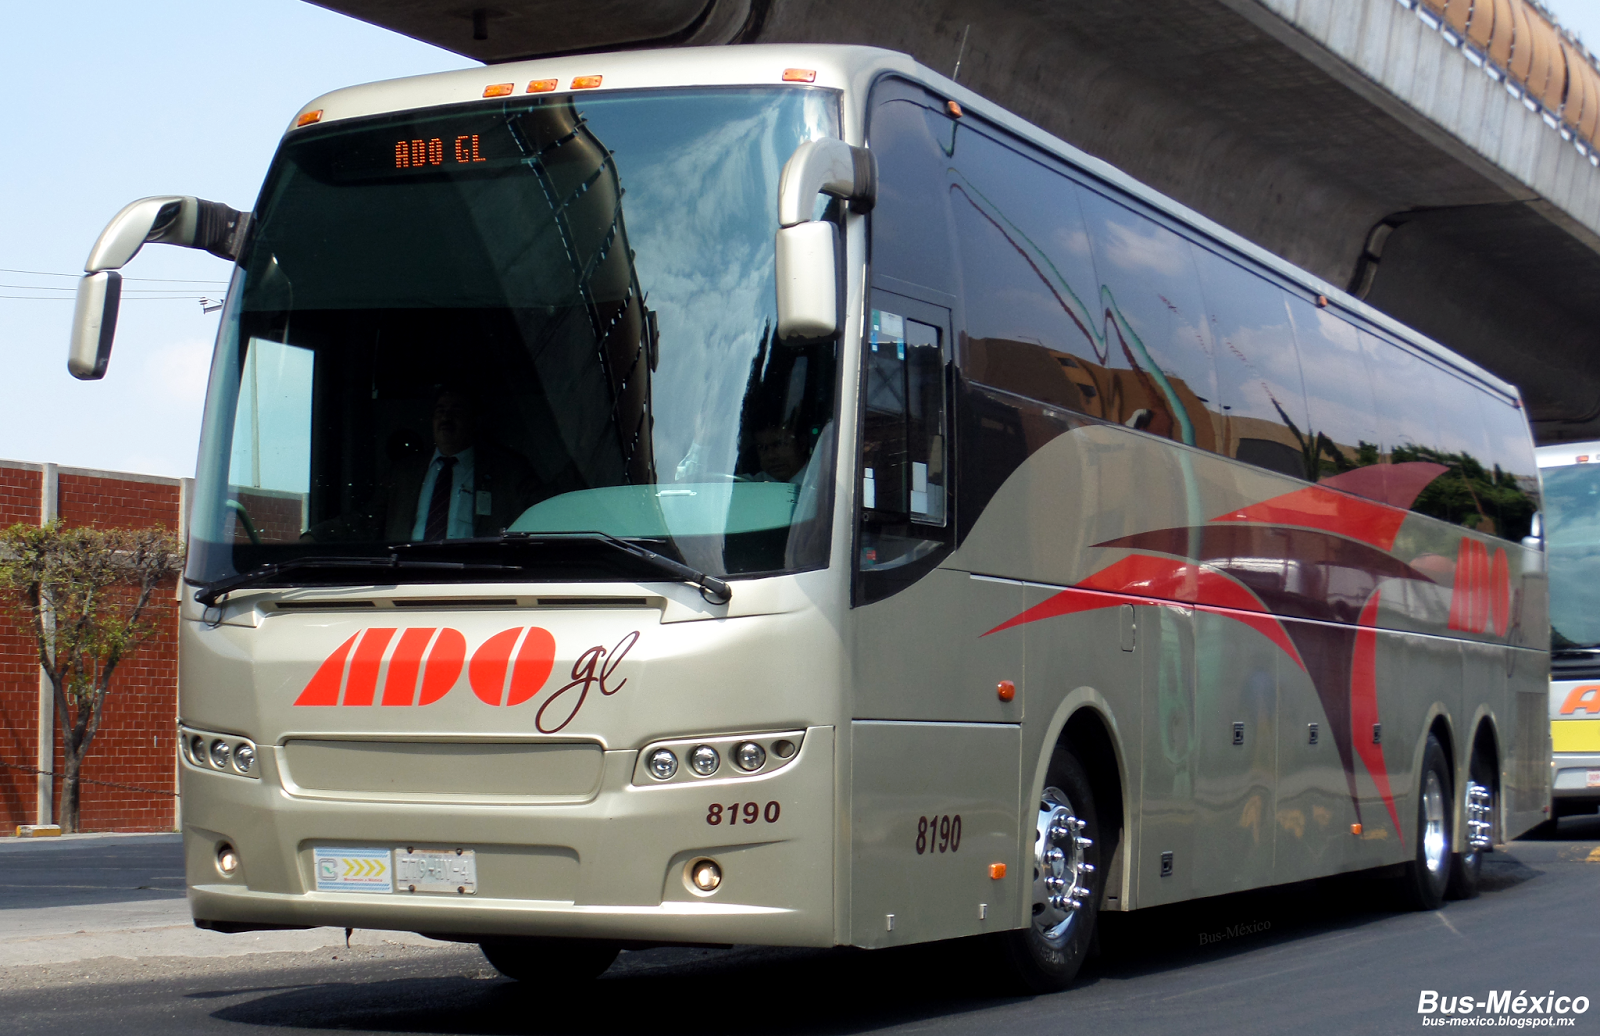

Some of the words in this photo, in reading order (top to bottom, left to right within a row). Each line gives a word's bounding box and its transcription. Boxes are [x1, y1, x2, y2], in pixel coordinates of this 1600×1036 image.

[395, 138, 443, 168] ADO
[455, 134, 487, 163] GL
[292, 626, 556, 707] ADO
[706, 800, 781, 826] 8190
[915, 814, 962, 855] 8190
